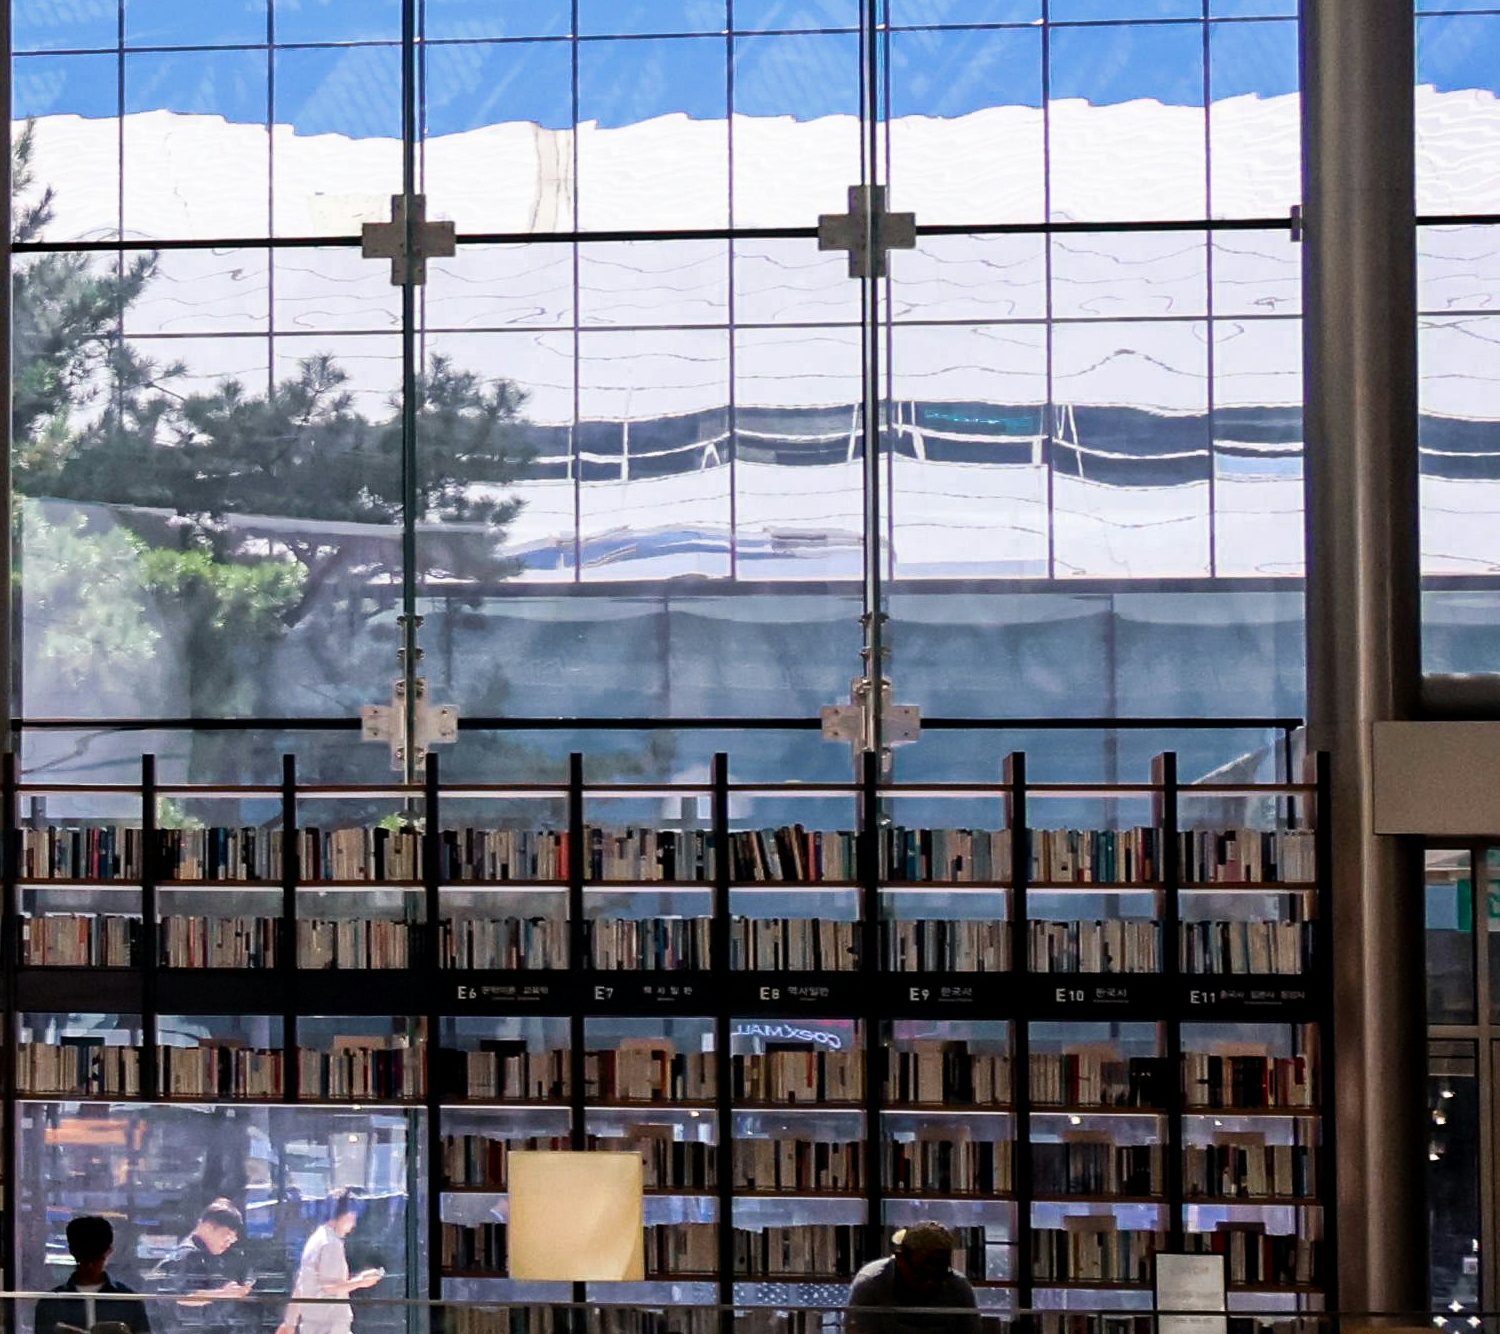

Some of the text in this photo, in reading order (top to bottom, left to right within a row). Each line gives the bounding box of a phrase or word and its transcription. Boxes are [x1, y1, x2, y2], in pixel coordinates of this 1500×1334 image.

[457, 985, 478, 1000] E6
[594, 985, 614, 1001] E7
[759, 986, 780, 1001] E8
[909, 986, 930, 1002] E9
[1055, 987, 1085, 1002] E10
[1189, 989, 1216, 1004] E11
